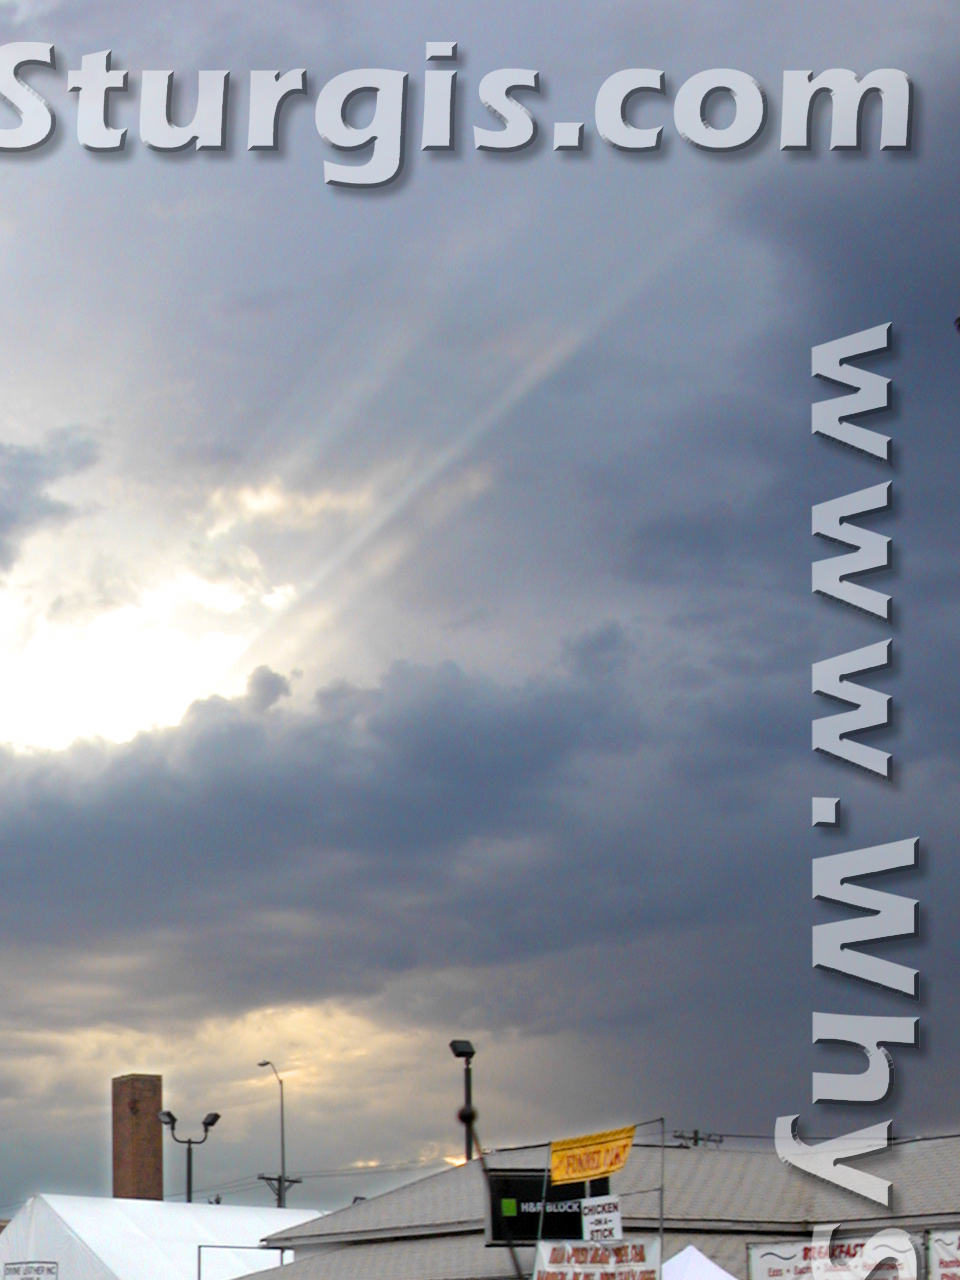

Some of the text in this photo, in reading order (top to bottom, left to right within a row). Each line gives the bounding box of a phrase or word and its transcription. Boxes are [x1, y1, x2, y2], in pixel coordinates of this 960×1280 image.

[545, 1202, 580, 1213] BLOCK
[582, 1202, 619, 1216] CHICKEN
[590, 1227, 615, 1241] STICK
[802, 1243, 866, 1261] BREAKFAST
